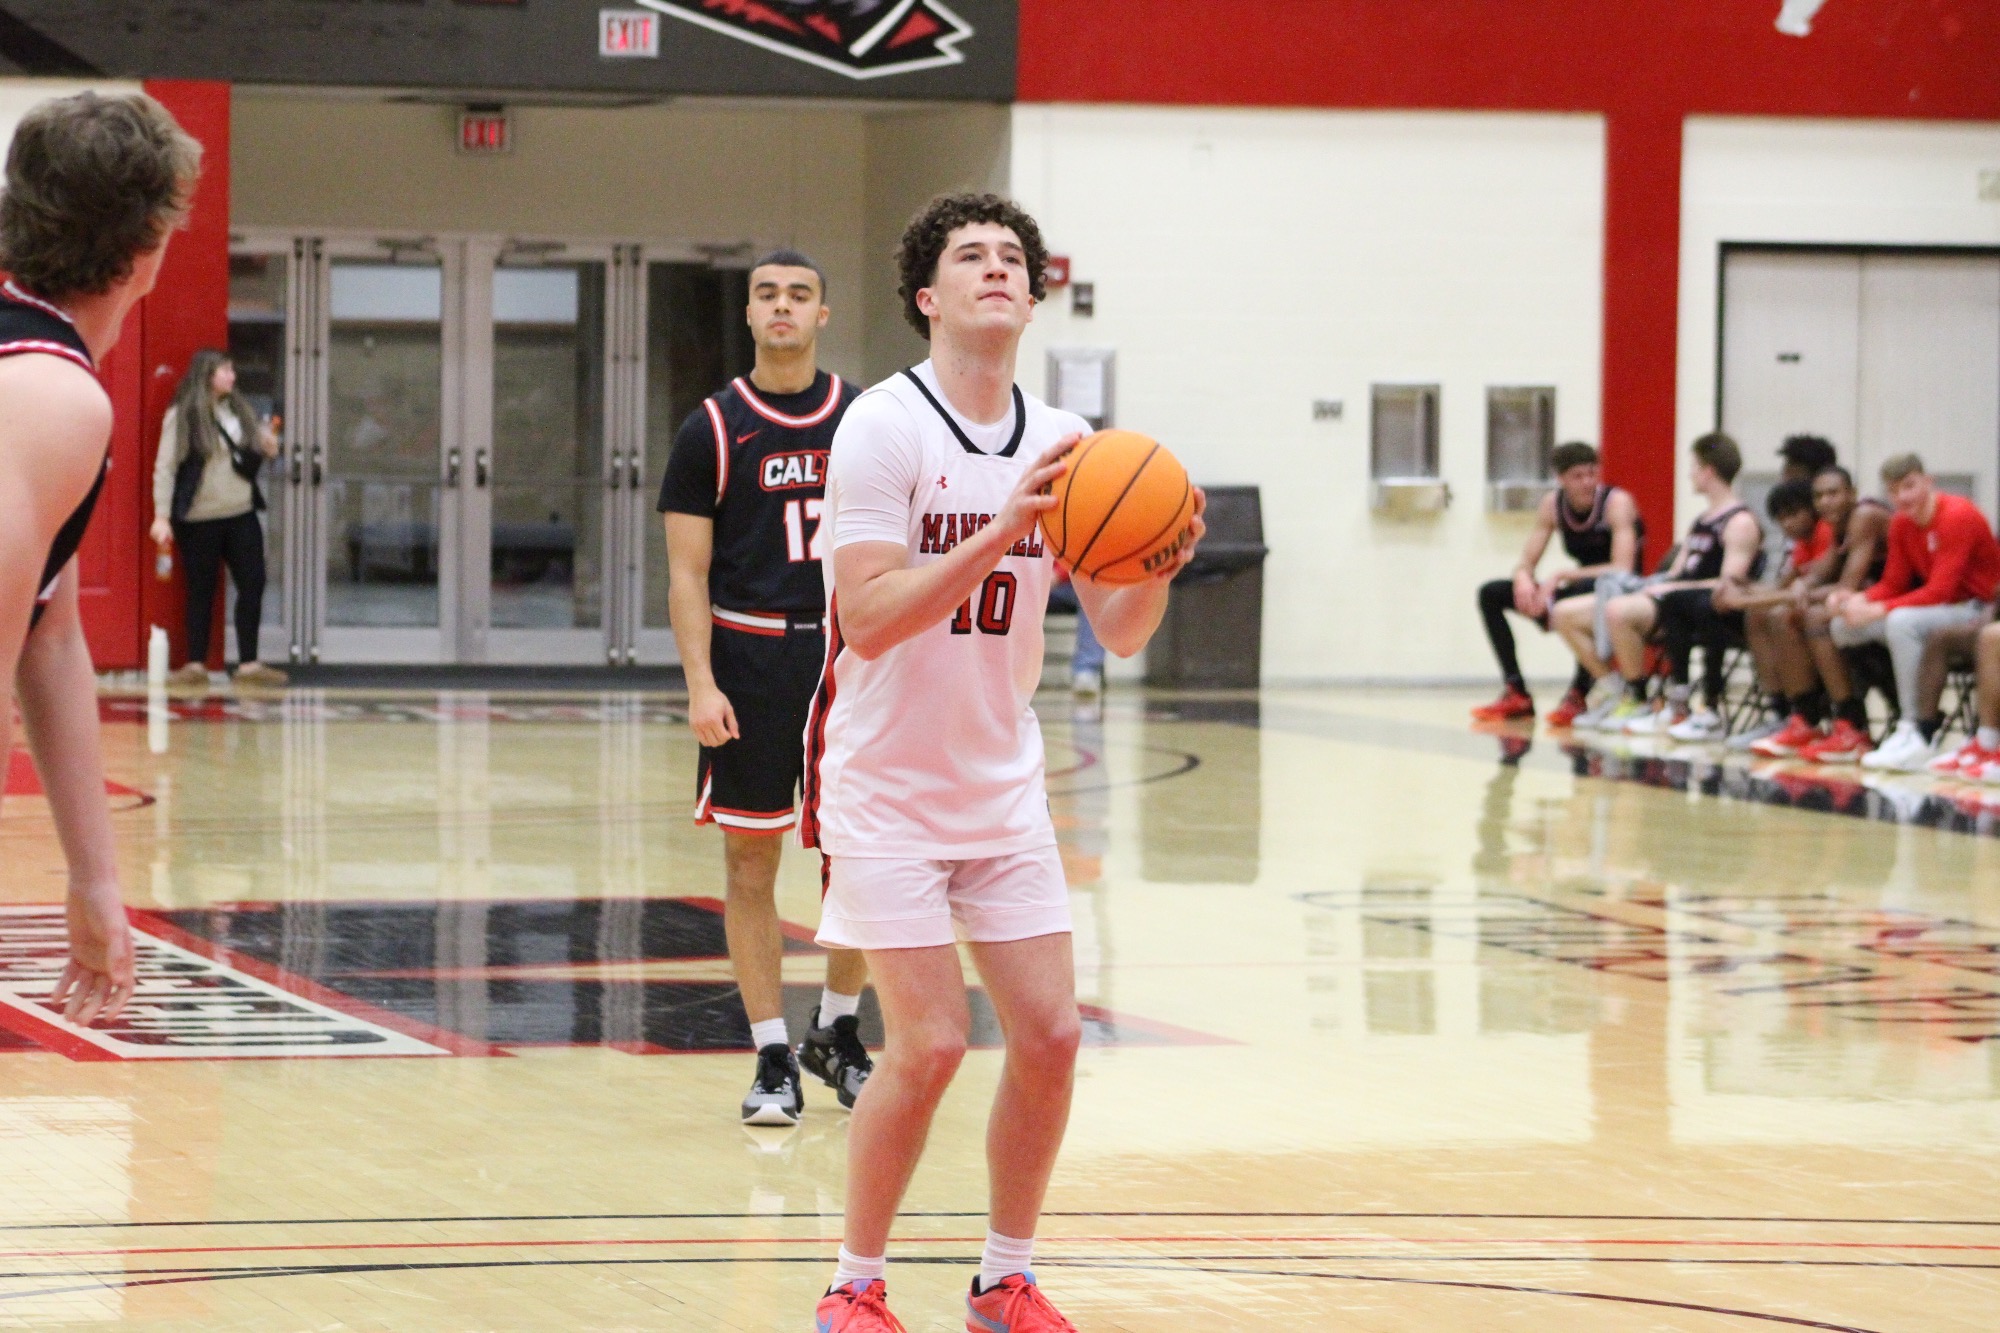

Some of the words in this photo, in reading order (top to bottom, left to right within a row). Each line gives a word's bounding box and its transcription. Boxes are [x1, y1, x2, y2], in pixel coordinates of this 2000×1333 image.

[606, 17, 650, 49] EXIT
[463, 118, 505, 147] EXIT
[919, 512, 1044, 559] MANEL
[950, 570, 1018, 636] 10
